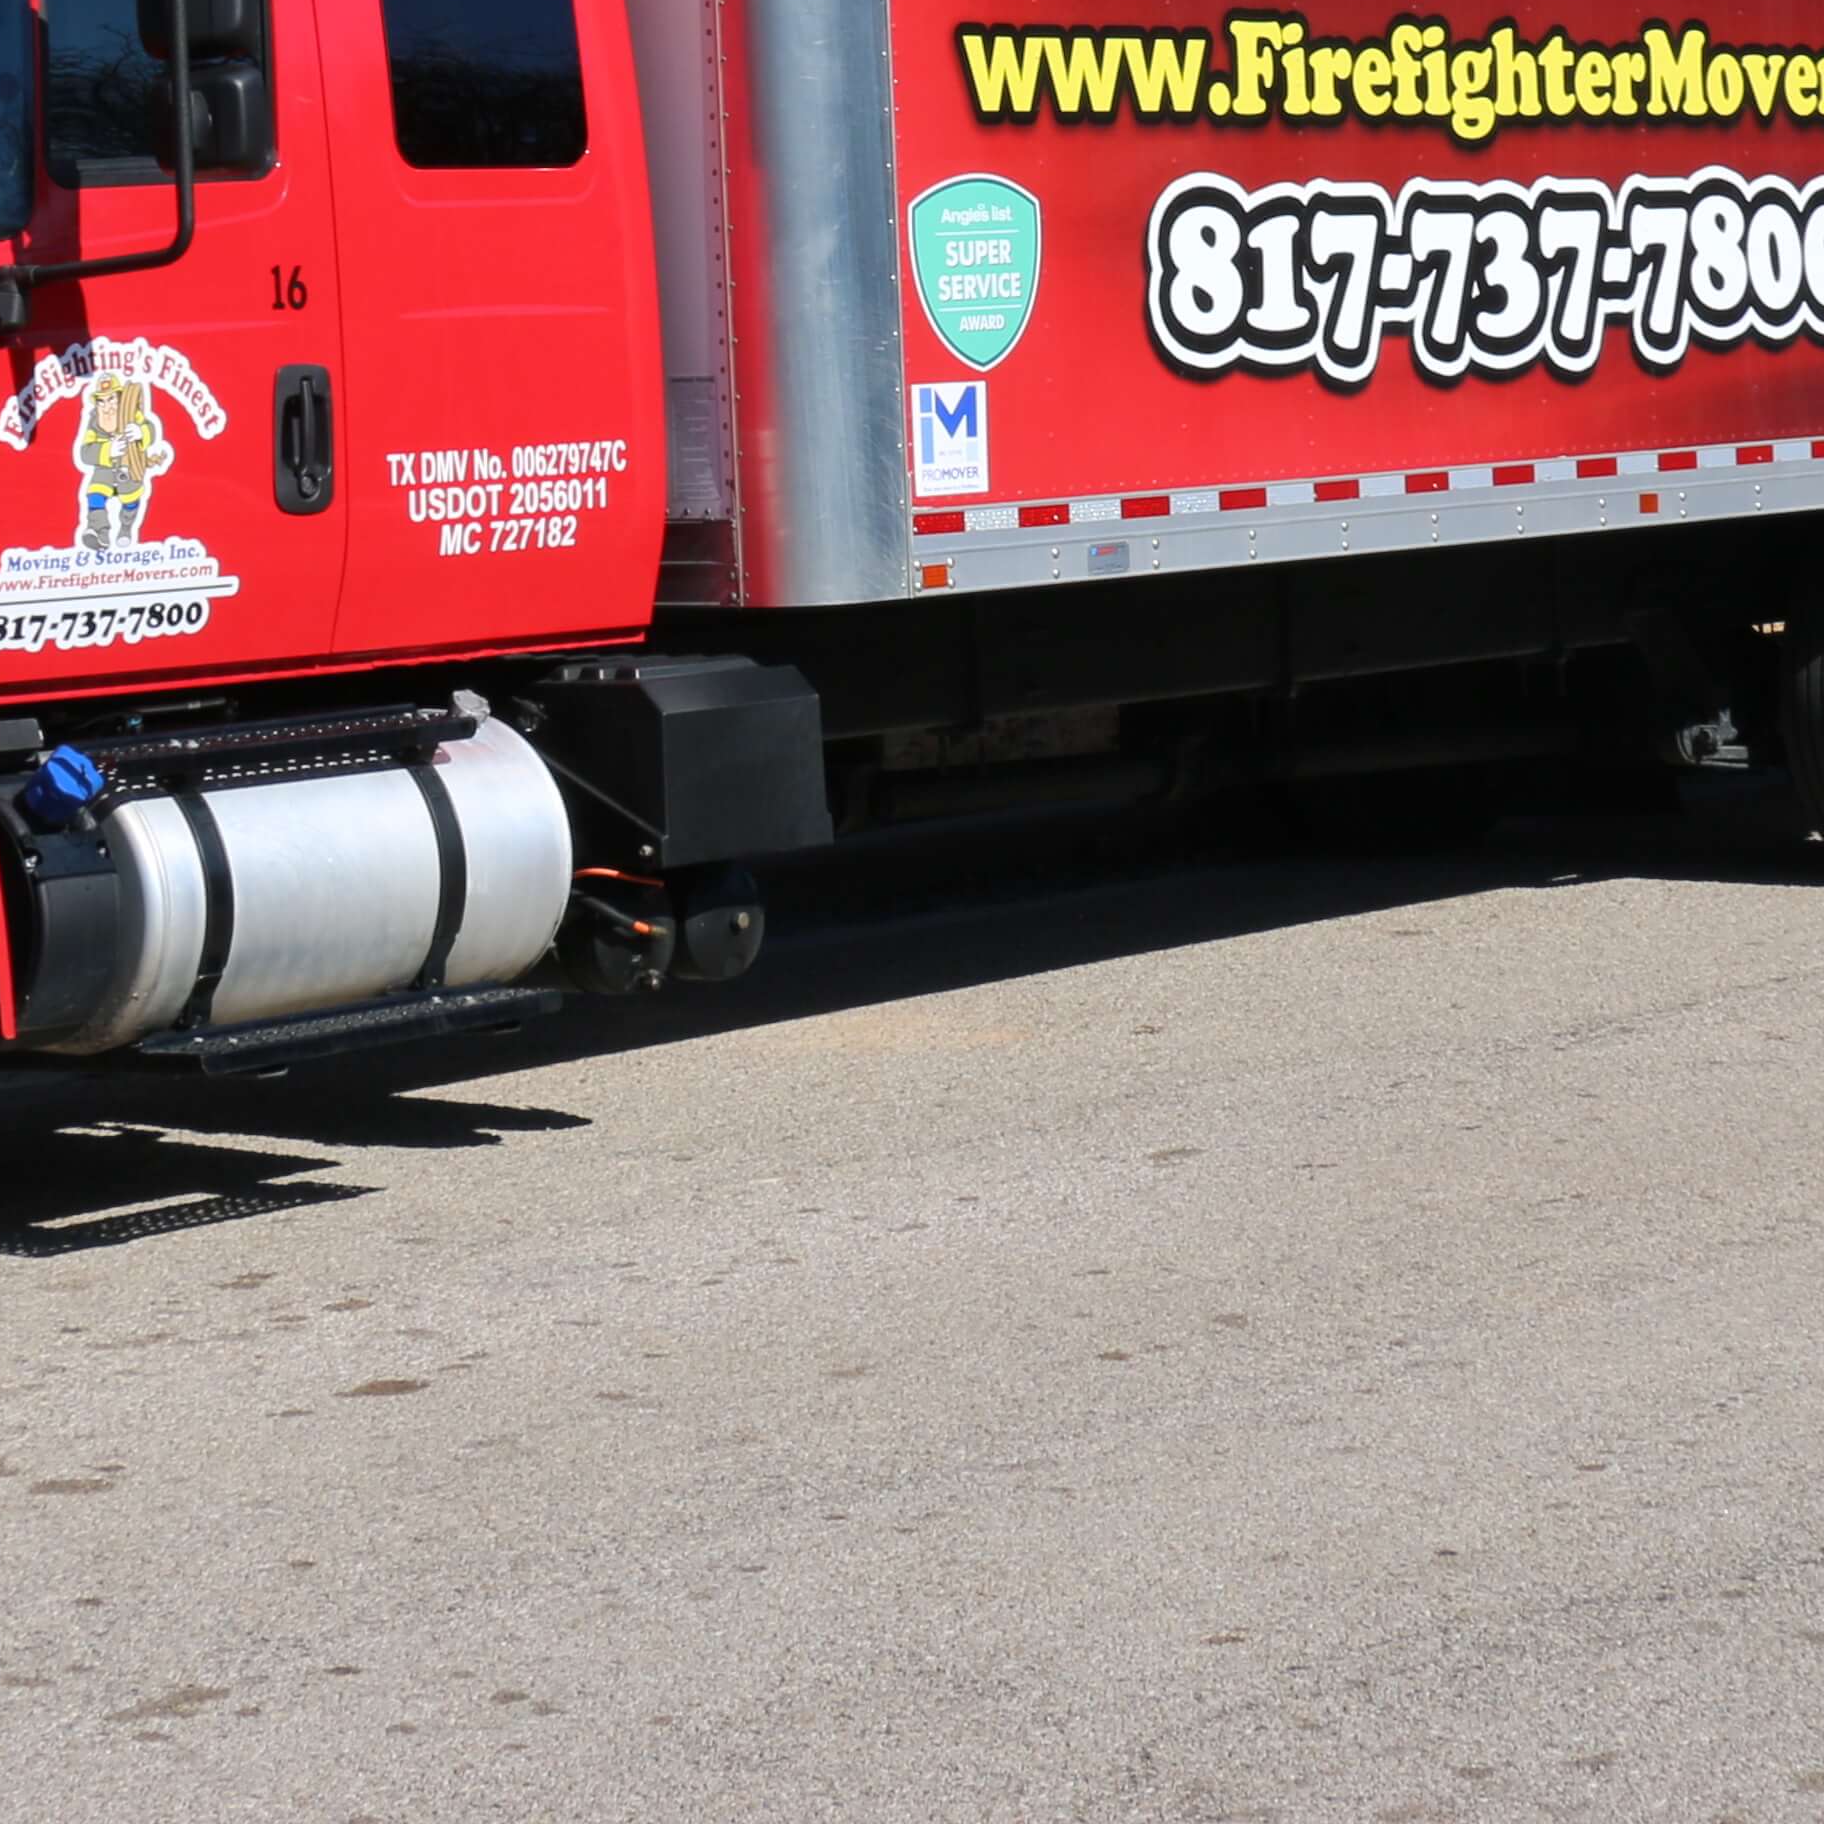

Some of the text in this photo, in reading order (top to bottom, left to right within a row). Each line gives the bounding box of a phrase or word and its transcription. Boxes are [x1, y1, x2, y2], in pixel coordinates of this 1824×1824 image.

[946, 239, 1012, 267] SUPER
[271, 265, 308, 311] 16
[938, 272, 1022, 302] SERVICE
[959, 314, 1005, 332] AWARD
[3, 346, 220, 440] Firefighting's Finest
[386, 440, 627, 487] TX DMV No. 006279747C
[408, 478, 608, 522] USDOT 2056011
[440, 516, 577, 557] MC 727182
[6, 544, 201, 573] Moving & Storage, Inc.
